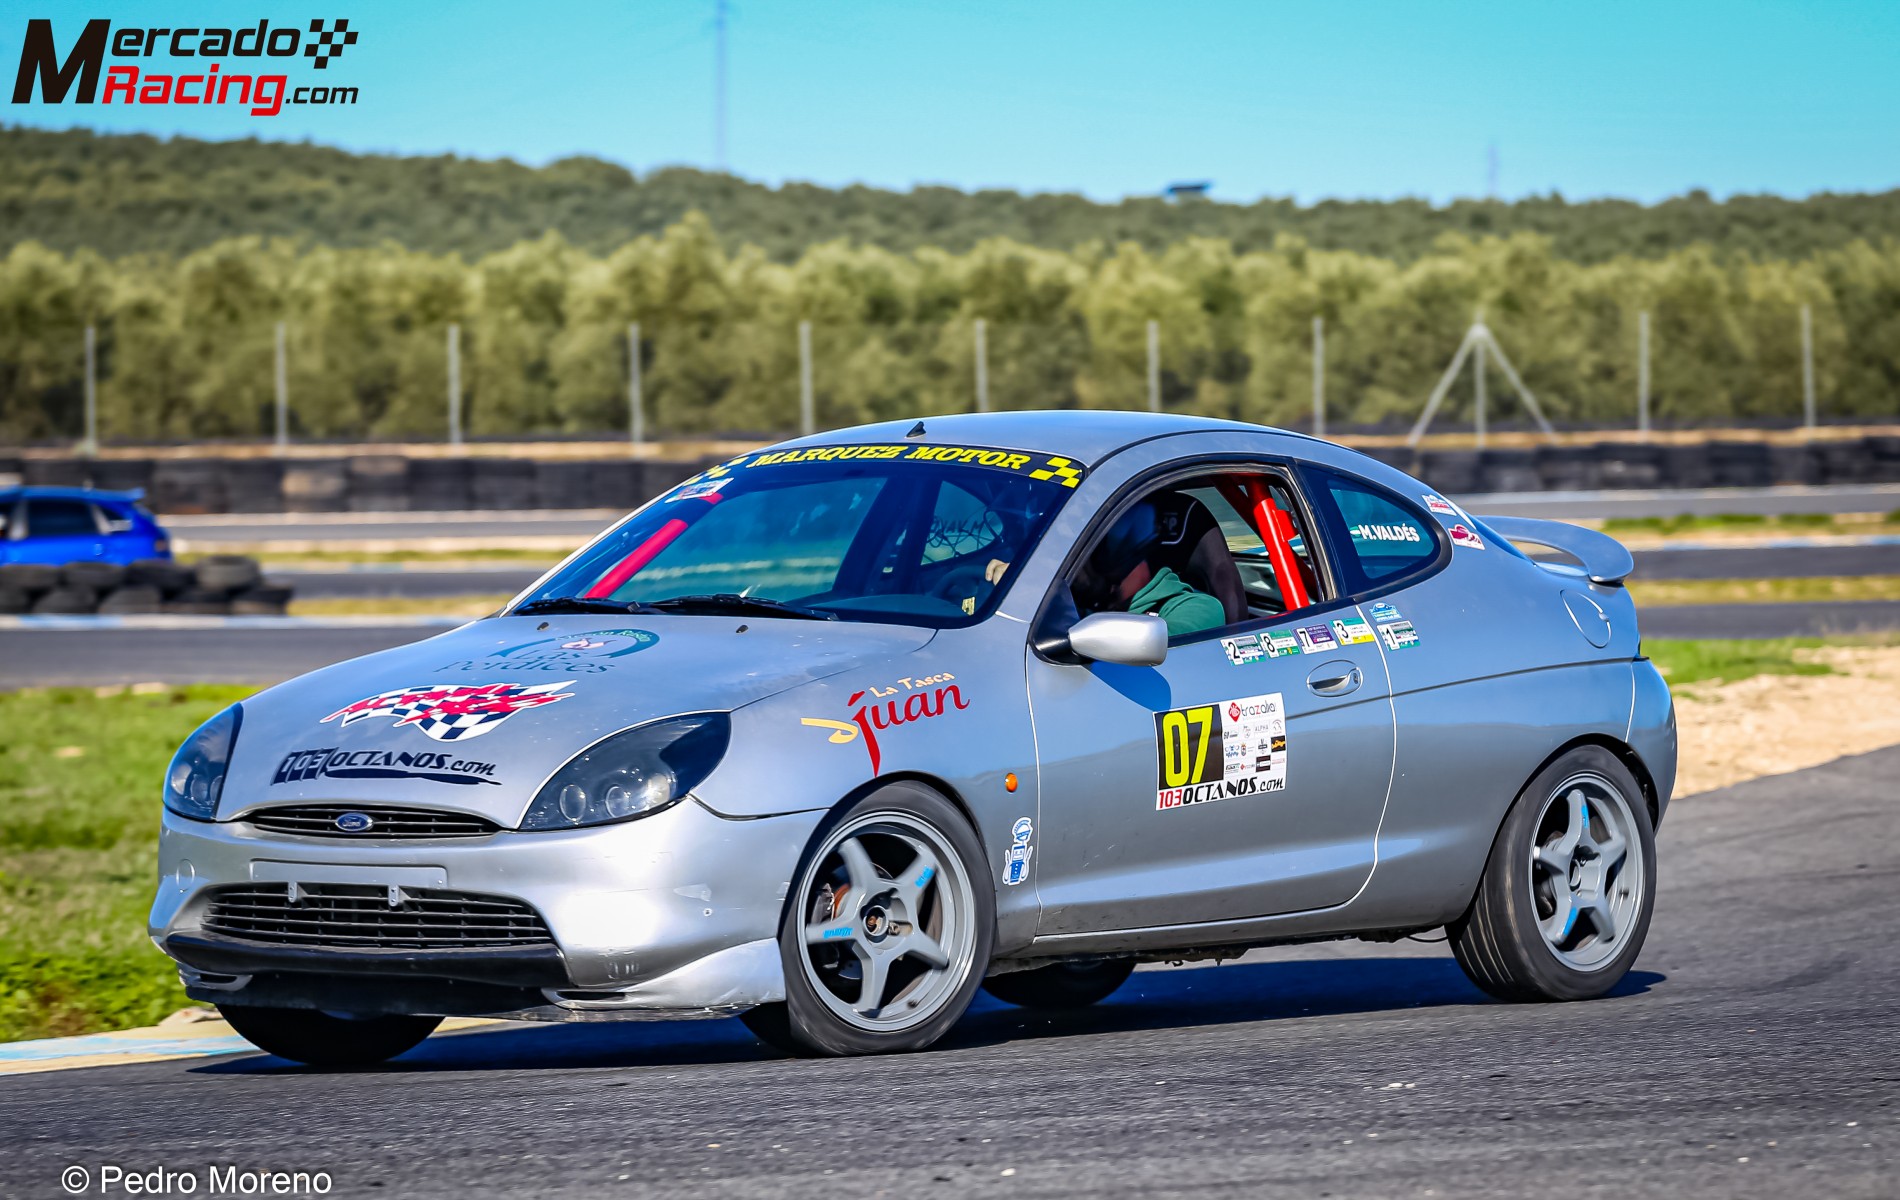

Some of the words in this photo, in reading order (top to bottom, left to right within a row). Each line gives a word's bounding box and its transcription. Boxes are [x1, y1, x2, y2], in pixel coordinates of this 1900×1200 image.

[746, 445, 909, 469] MARQUEZ
[905, 446, 1032, 470] MOTOR
[1299, 630, 1310, 648] 7
[1336, 622, 1349, 639] 3
[1386, 628, 1395, 645] 1
[1228, 641, 1241, 659] 2
[1263, 635, 1276, 653] 8
[869, 686, 898, 698] La
[897, 672, 955, 690] Tasca
[1163, 706, 1213, 788] 07
[1159, 776, 1284, 809] 103OCTANOS.com
